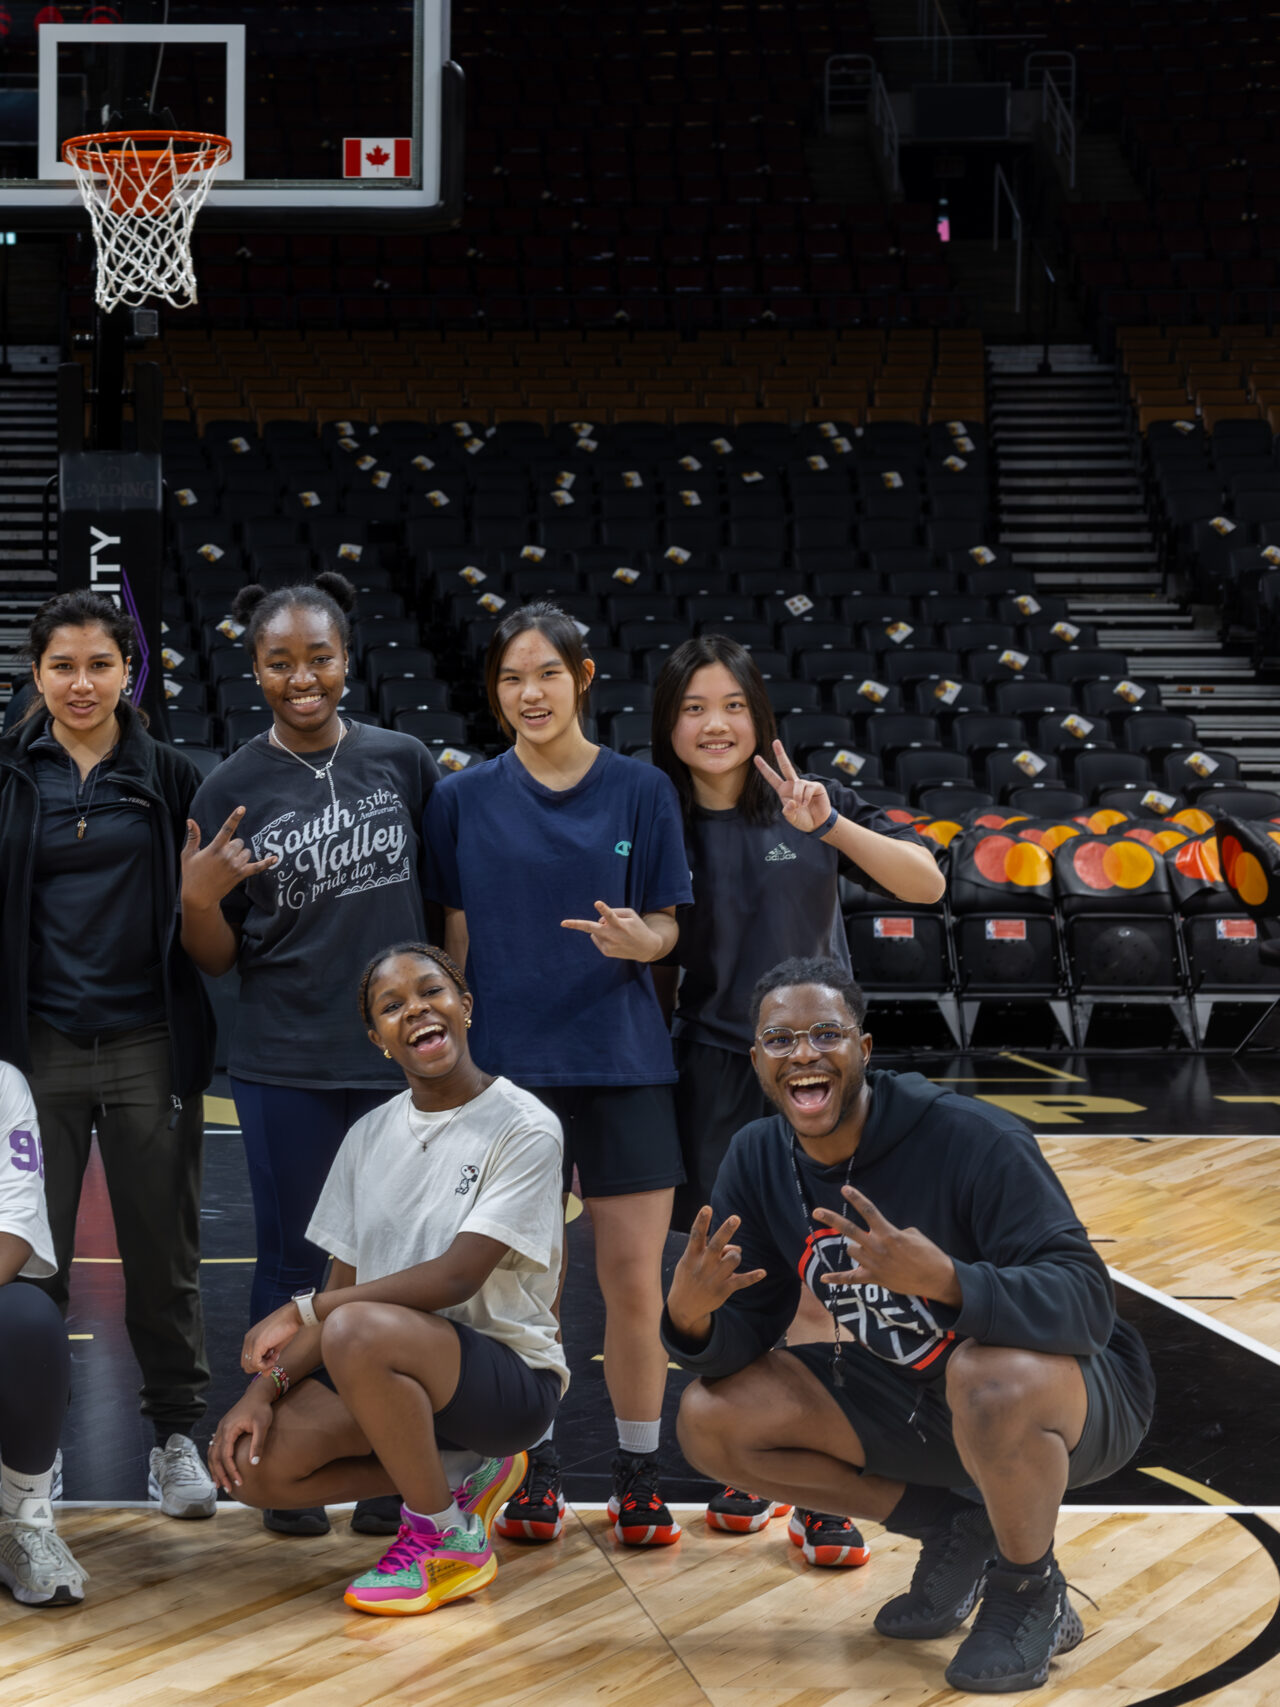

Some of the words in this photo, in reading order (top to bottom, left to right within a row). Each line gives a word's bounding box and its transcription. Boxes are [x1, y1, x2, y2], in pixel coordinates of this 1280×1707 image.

[90, 525, 121, 609] ITY
[263, 800, 355, 870] South
[296, 820, 408, 882] Valley
[311, 869, 347, 903] pride
[351, 861, 377, 880] day
[9, 1129, 44, 1179] 9
